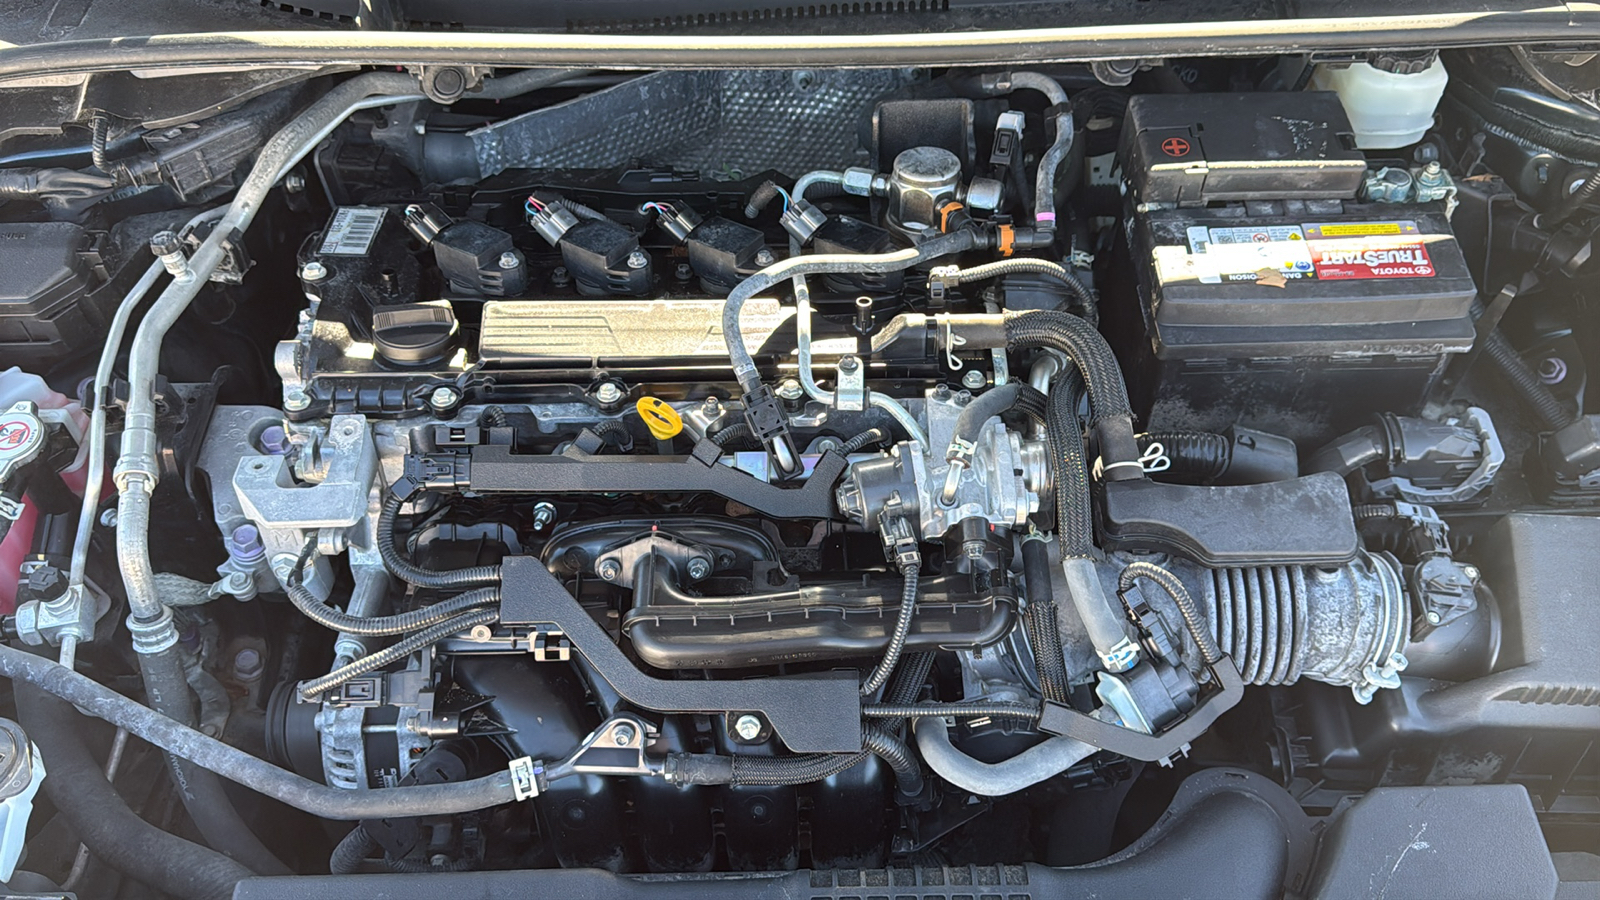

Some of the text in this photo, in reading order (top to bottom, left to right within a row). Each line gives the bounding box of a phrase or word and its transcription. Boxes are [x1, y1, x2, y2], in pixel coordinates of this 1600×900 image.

[1319, 249, 1428, 267] TRUESTART
[1370, 266, 1415, 276] TOYOTA
[1228, 273, 1258, 281] OISON
